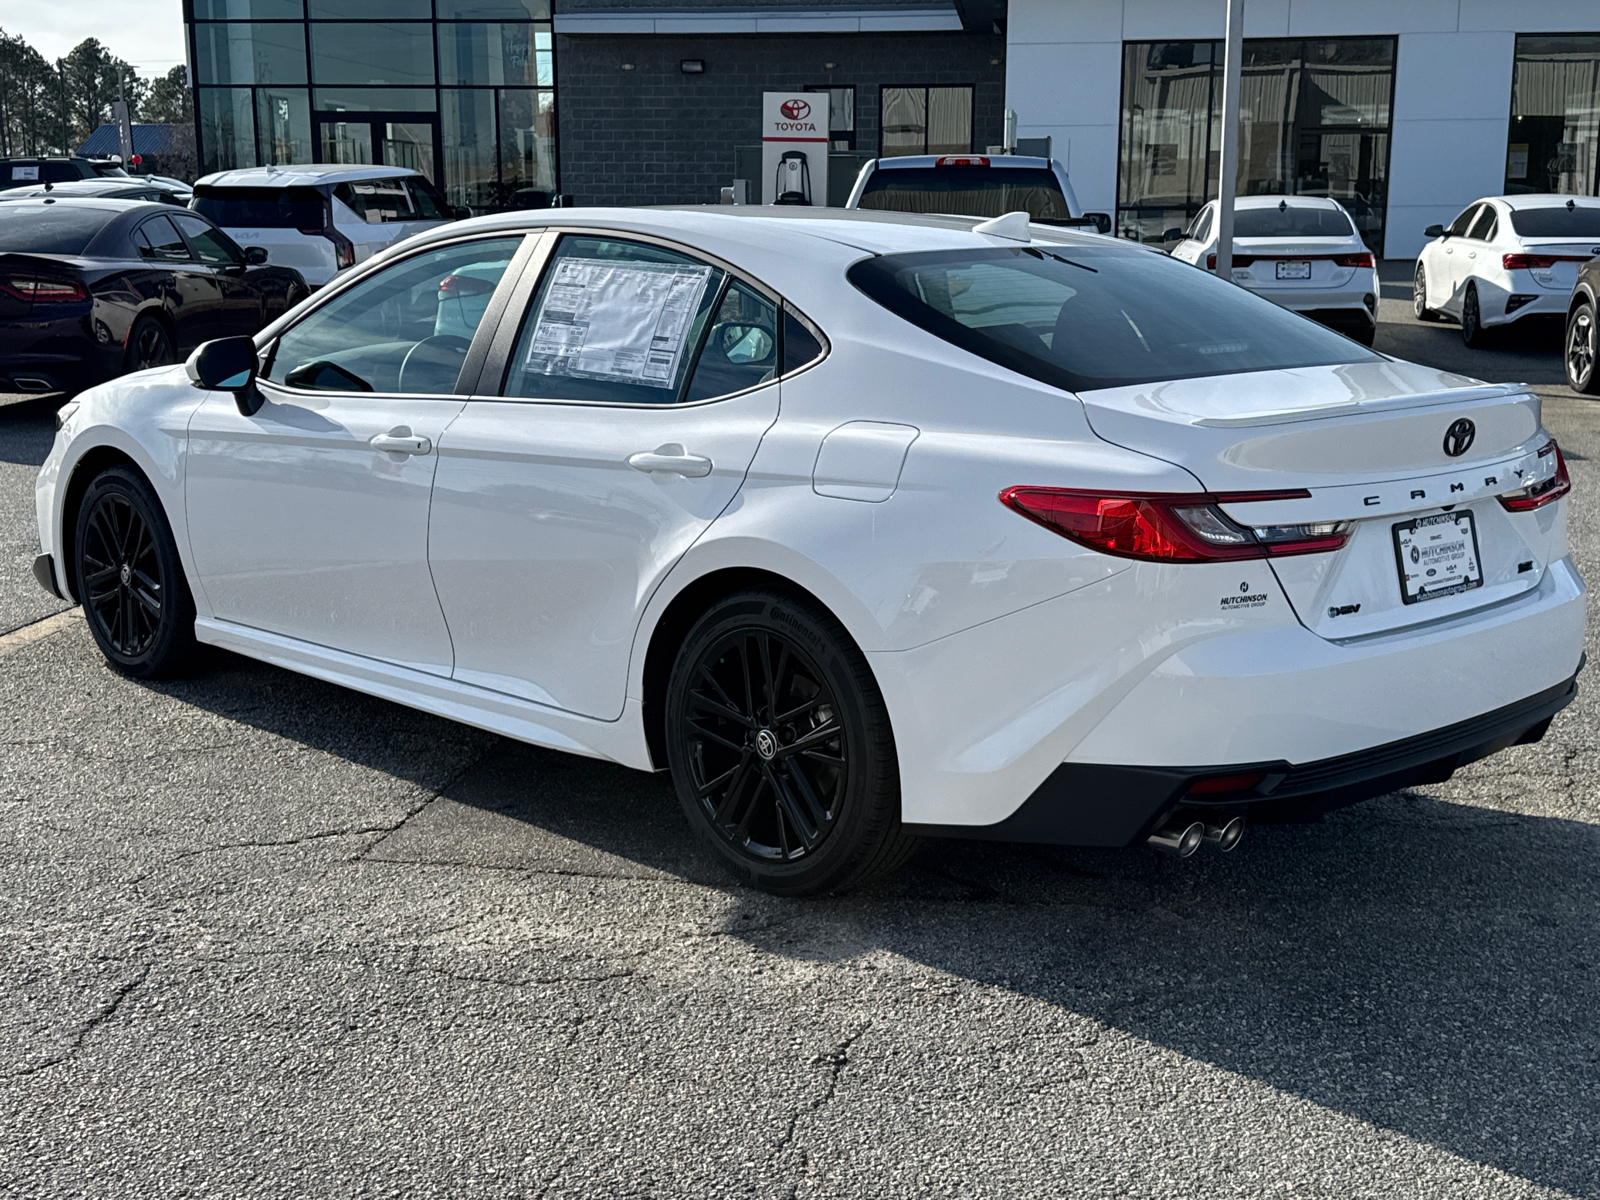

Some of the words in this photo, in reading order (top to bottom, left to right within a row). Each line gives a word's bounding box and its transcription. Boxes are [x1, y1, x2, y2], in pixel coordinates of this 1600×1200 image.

[774, 122, 816, 132] TOYOTA
[1363, 469, 1524, 506] CAMRY
[1422, 513, 1457, 527] HUTCHINSON
[1421, 541, 1466, 559] HUTCHINSON
[1423, 554, 1451, 566] AUTOMOTIVE
[1451, 551, 1465, 561] GROUP
[1220, 593, 1268, 606] HUTCHINSON
[770, 606, 822, 648] Continental
